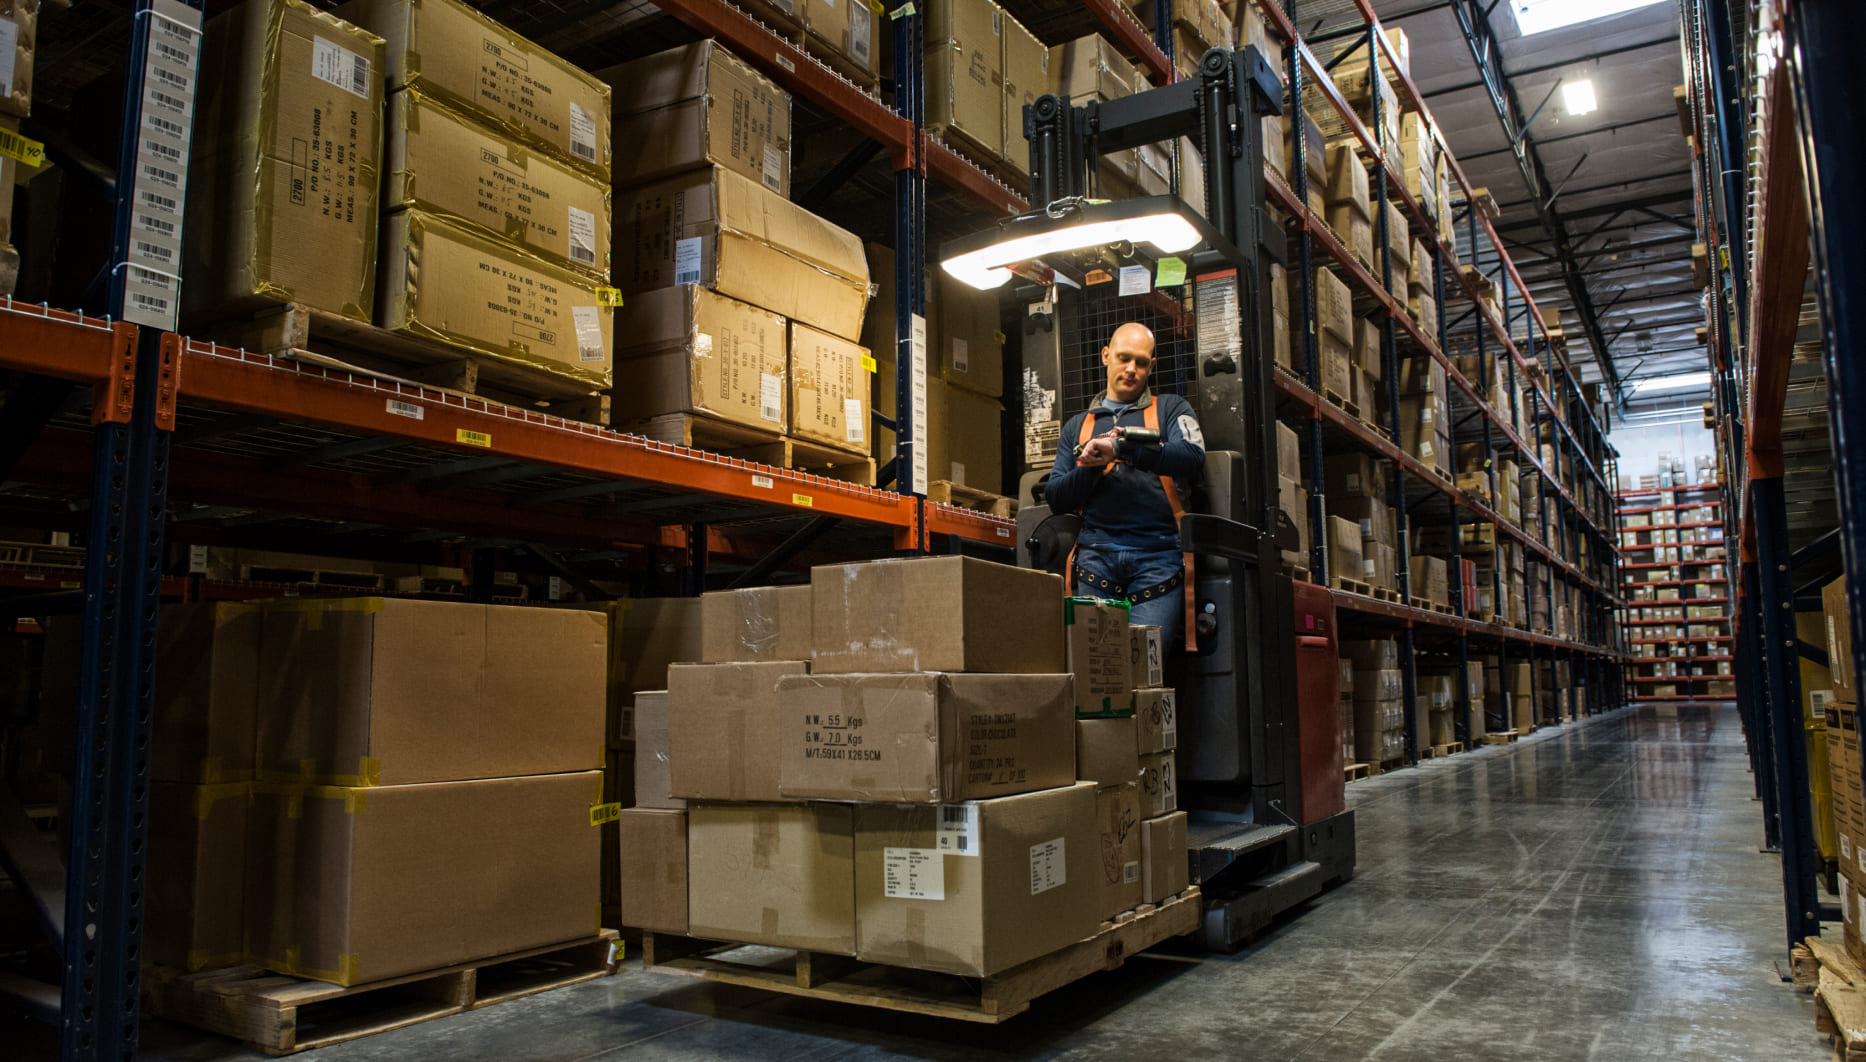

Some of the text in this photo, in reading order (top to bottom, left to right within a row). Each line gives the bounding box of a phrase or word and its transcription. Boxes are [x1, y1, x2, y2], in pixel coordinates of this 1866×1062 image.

[350, 110, 358, 126] CM
[293, 178, 303, 201] 2700
[847, 715, 863, 730] Kgs
[847, 733, 863, 746] Kgs
